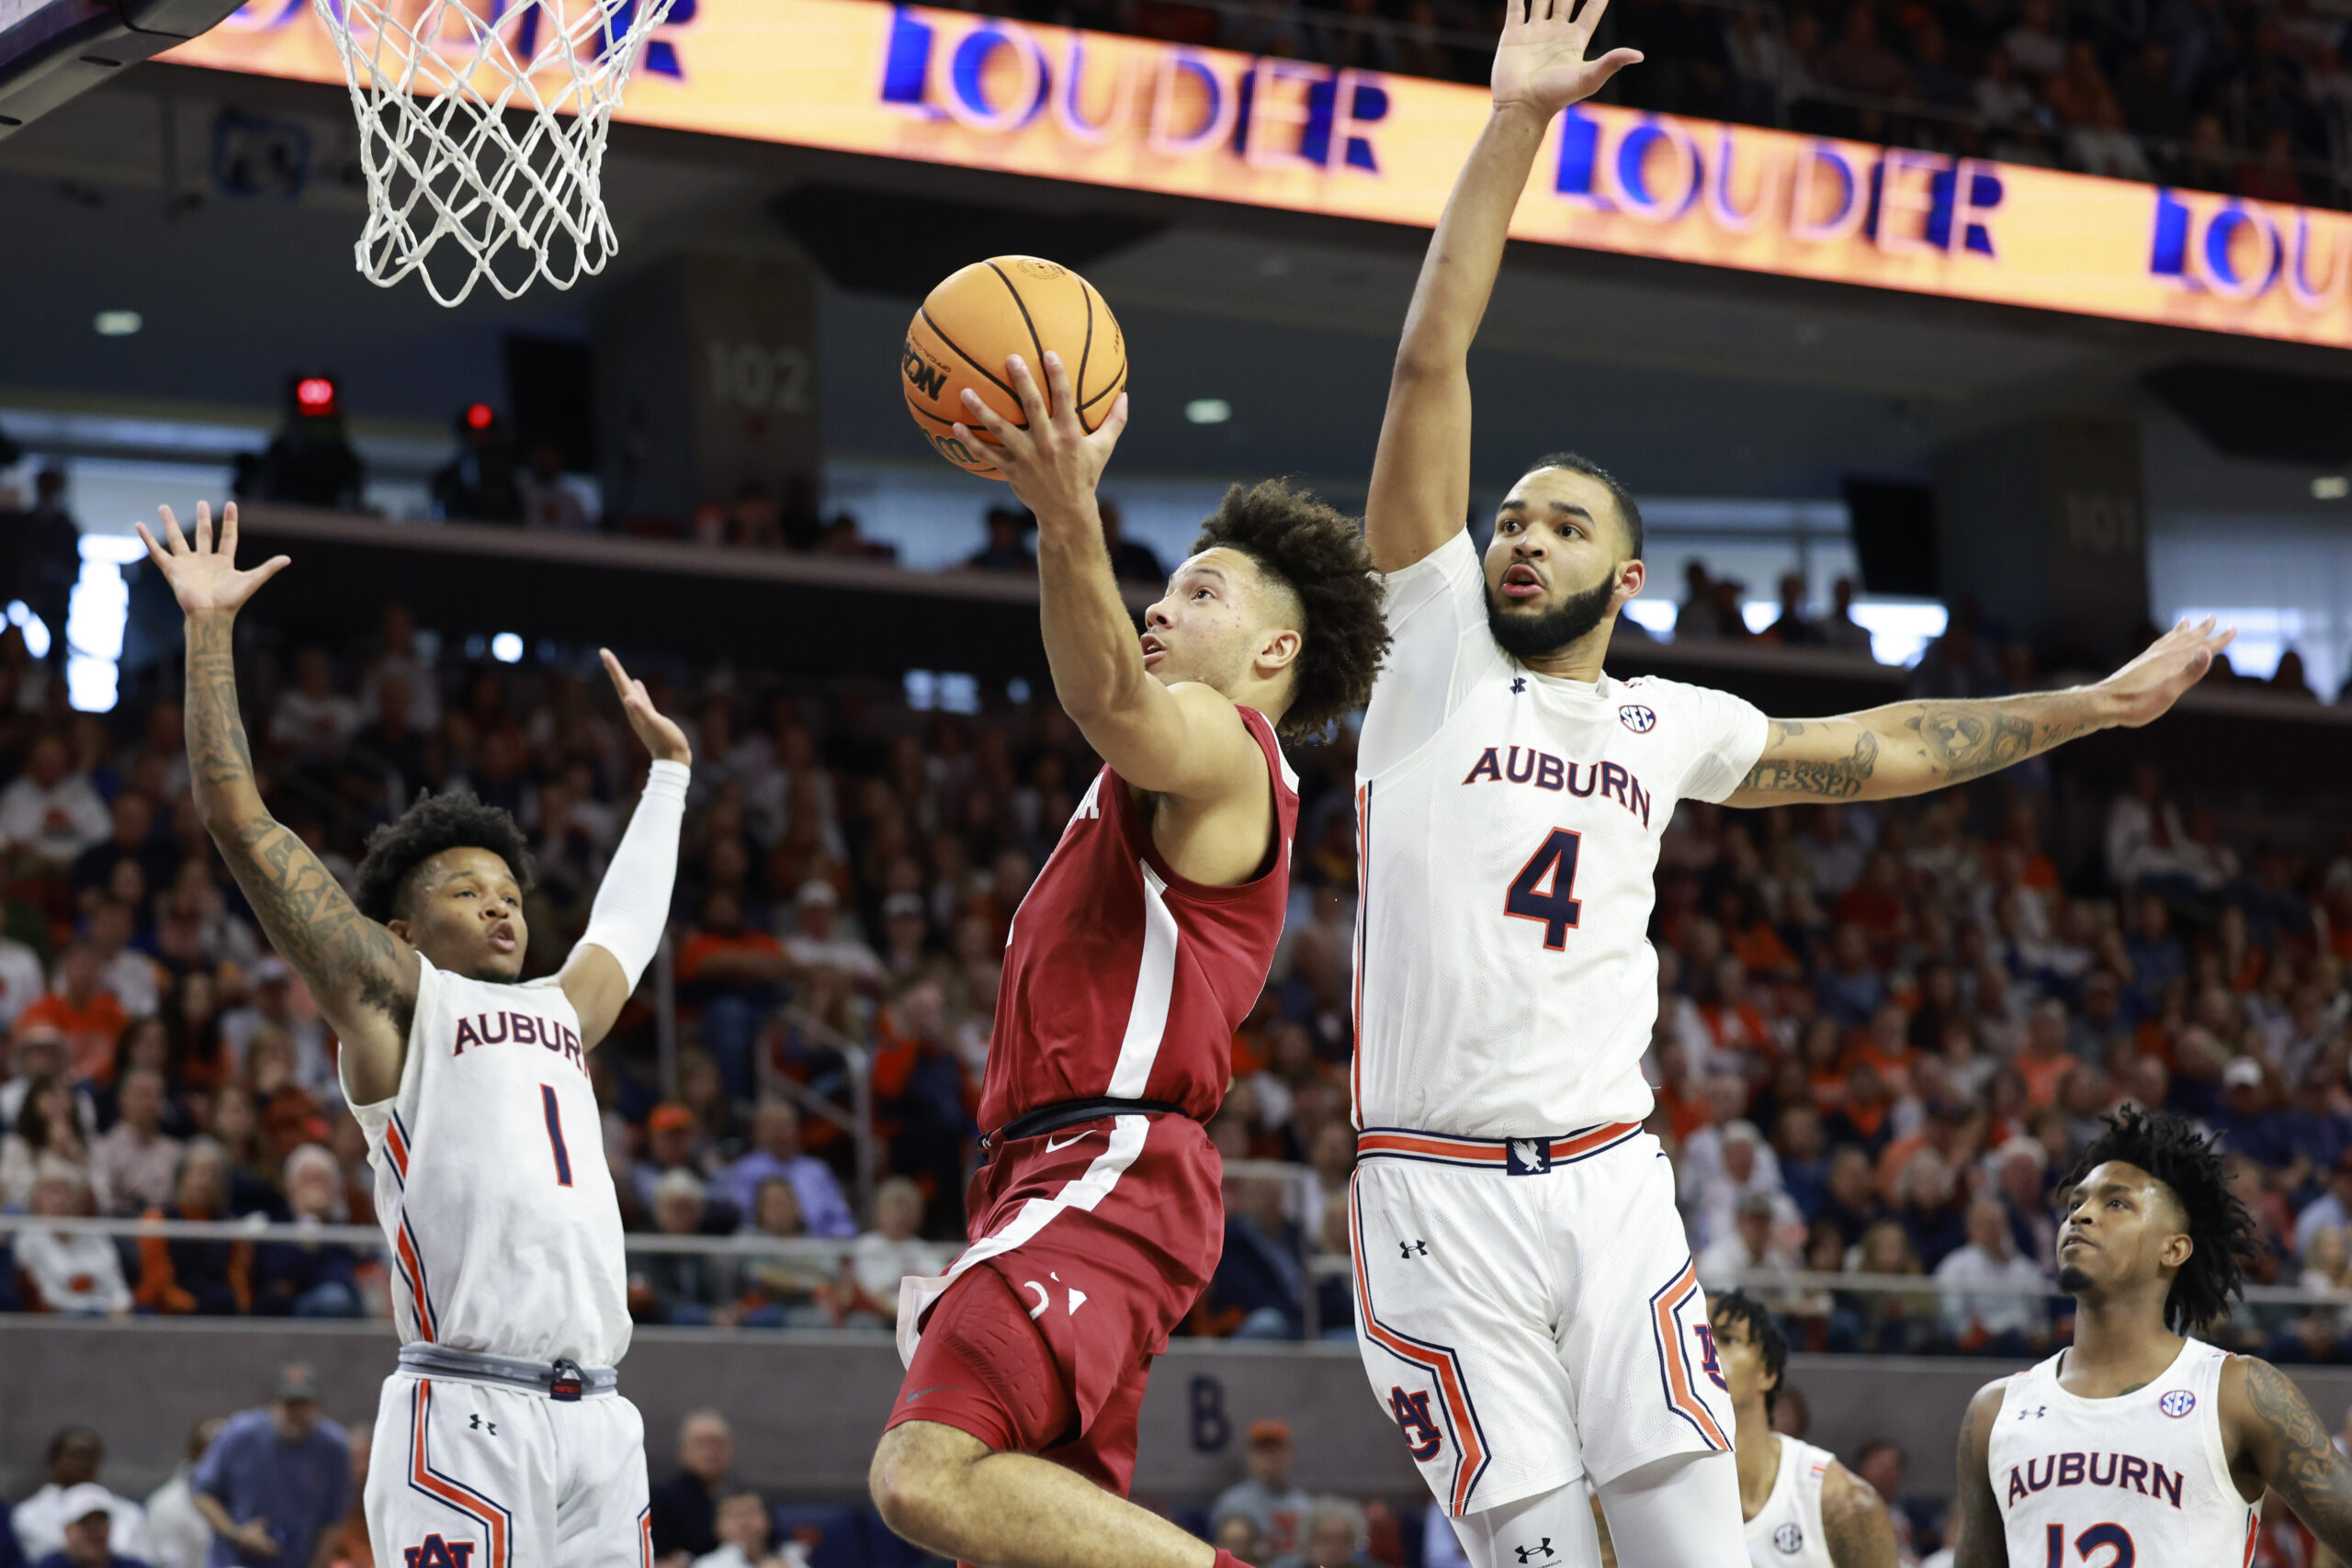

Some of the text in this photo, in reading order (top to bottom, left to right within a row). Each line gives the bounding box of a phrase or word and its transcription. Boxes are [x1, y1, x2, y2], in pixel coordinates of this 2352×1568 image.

[876, 4, 1395, 176] LOUDER
[1553, 107, 2007, 261] LOUDER
[707, 340, 811, 412] 102
[1619, 705, 1657, 733] SEC
[1461, 745, 1651, 831] AUBURN
[1503, 826, 1582, 952] 4
[453, 1011, 589, 1080] AUBUR
[539, 1083, 573, 1188] 1
[1189, 1371, 1231, 1454] B
[2159, 1390, 2197, 1418] SEC
[2008, 1451, 2185, 1510] AUBURN
